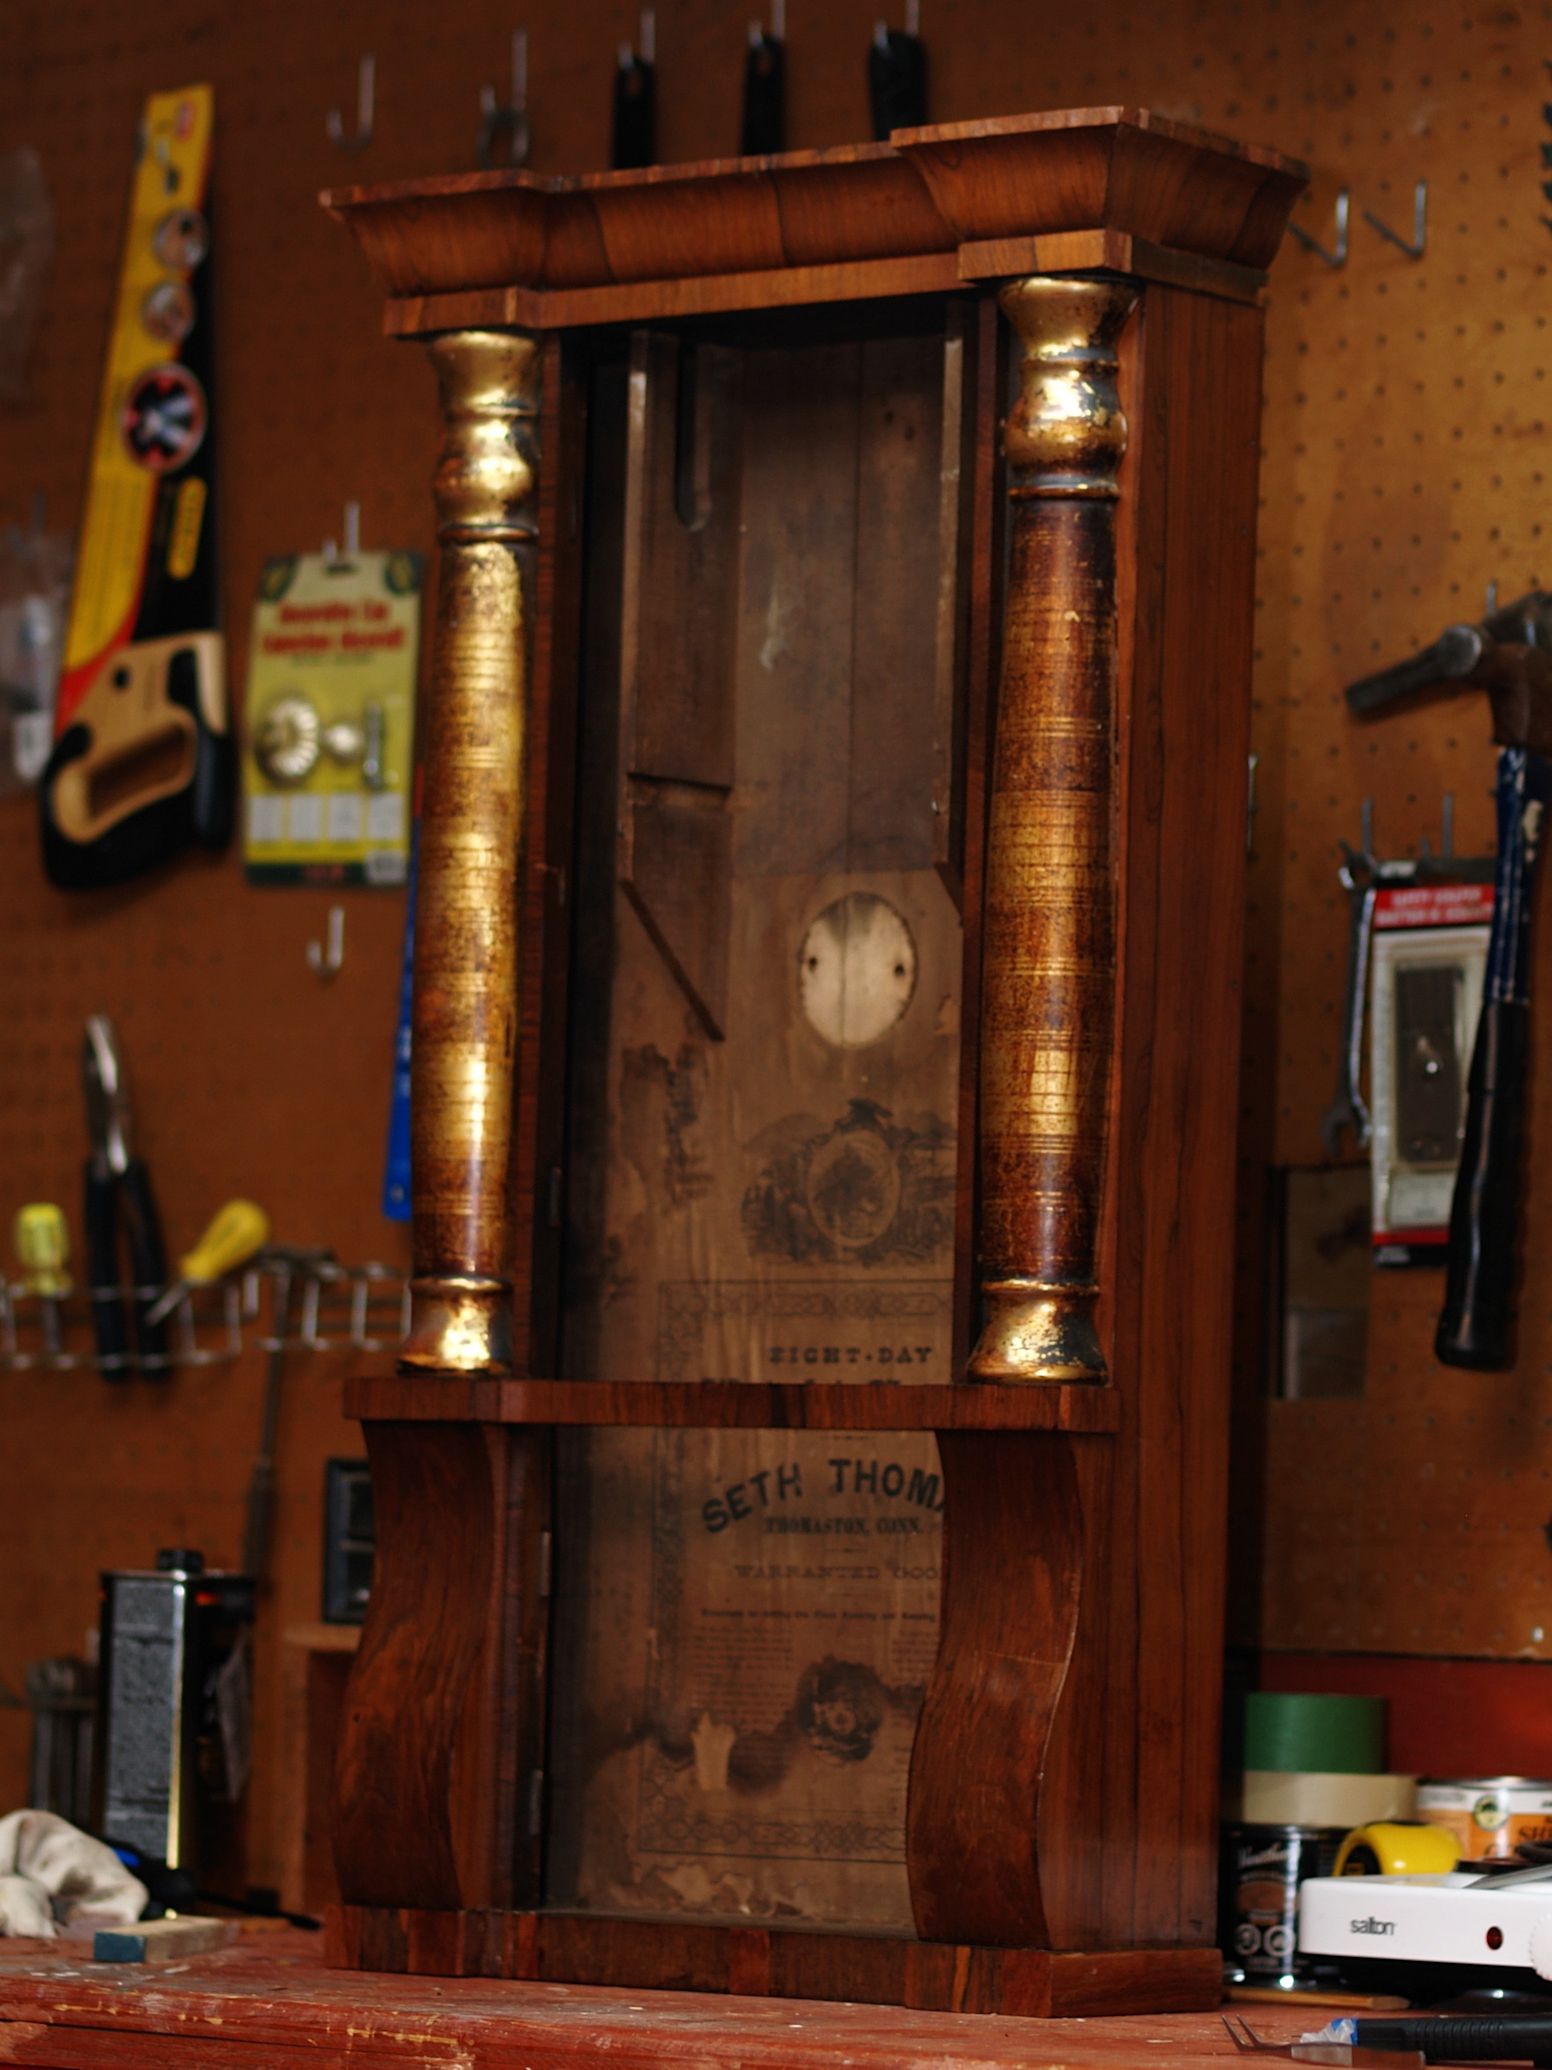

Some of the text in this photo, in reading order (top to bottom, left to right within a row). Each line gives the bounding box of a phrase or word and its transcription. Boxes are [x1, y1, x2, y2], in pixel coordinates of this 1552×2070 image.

[702, 1458, 945, 1533] SETH THOM
[1350, 1916, 1394, 1935] salton
